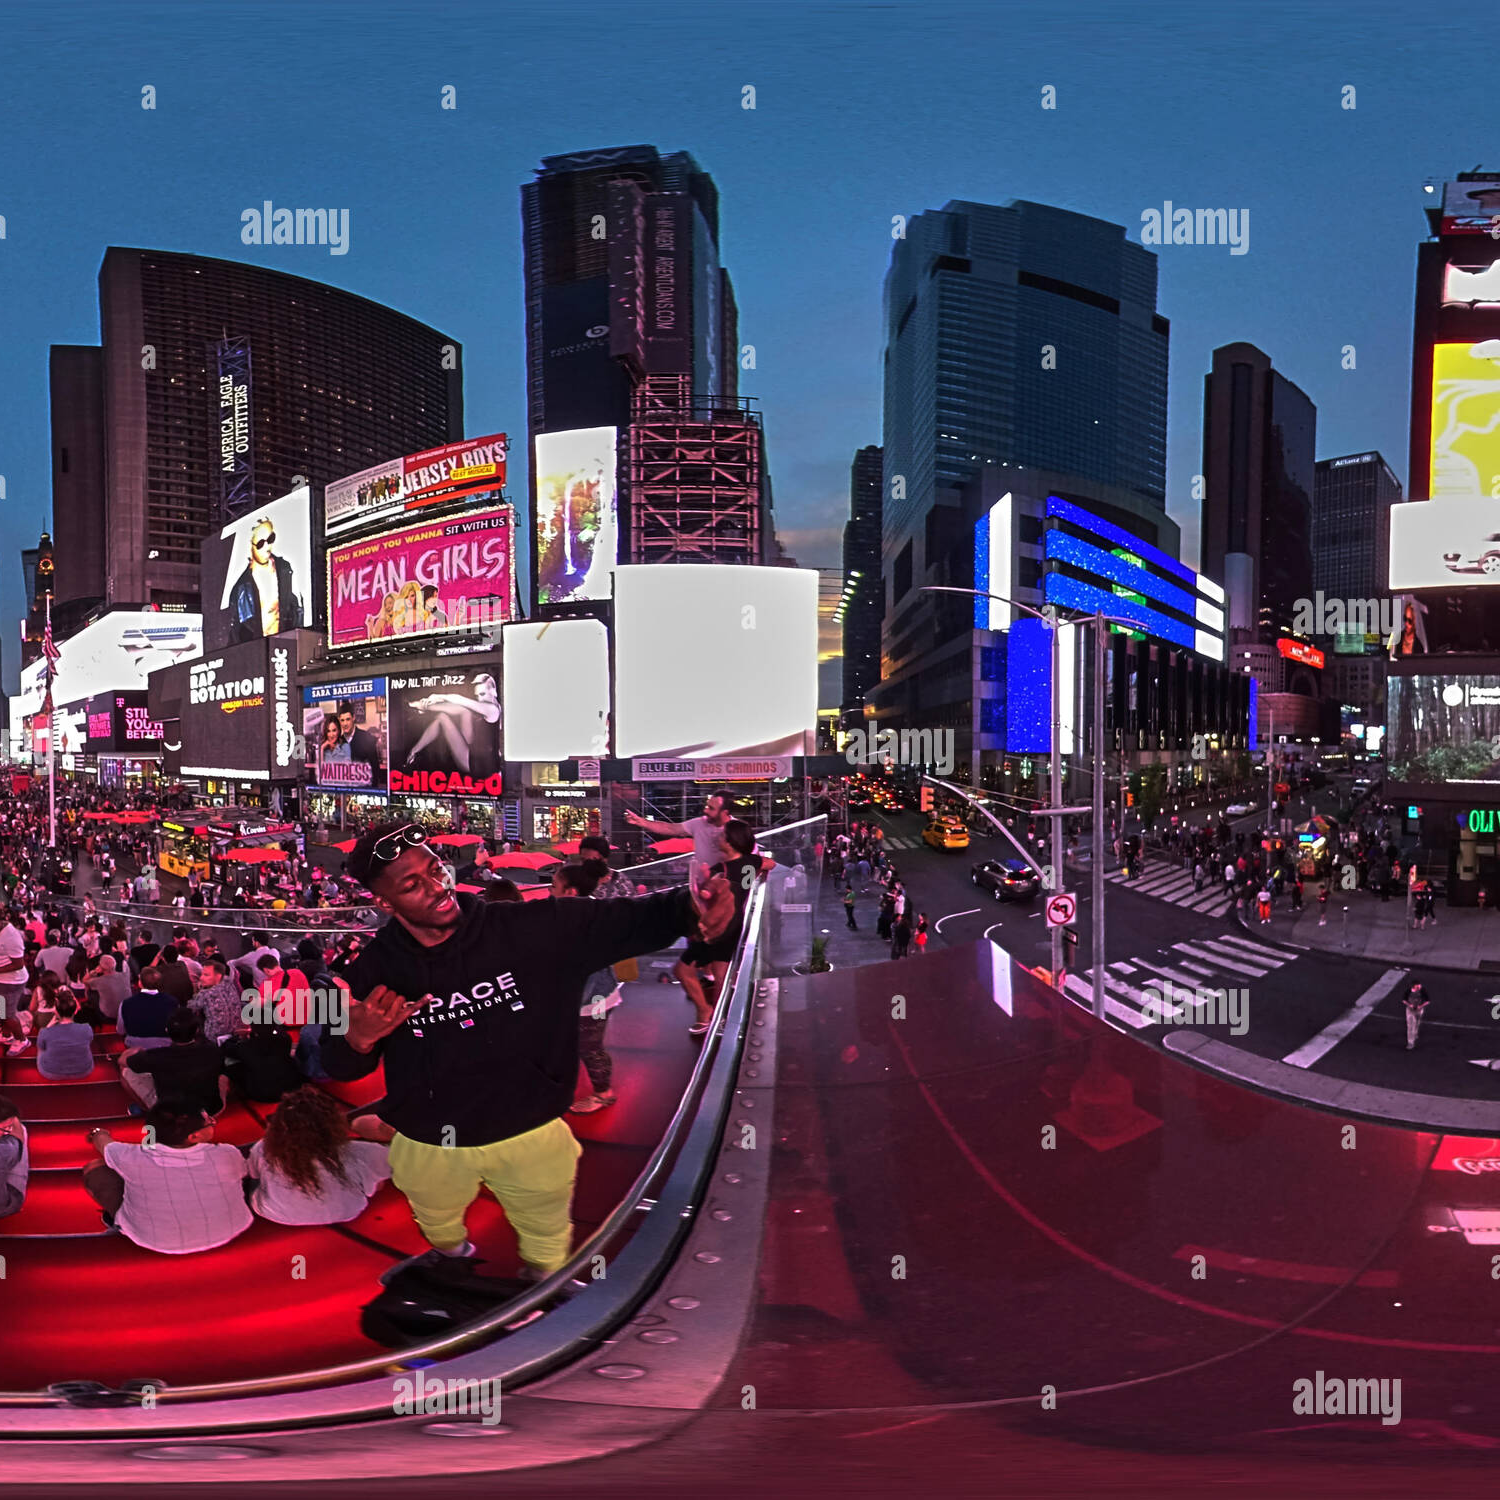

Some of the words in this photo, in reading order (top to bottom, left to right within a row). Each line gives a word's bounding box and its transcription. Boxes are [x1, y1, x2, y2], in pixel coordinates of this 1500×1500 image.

[655, 256, 675, 330] ARGENTLOANS.COM
[220, 374, 233, 408] EAGLE
[234, 384, 249, 453] OUTFITTERS
[221, 416, 235, 472] AMERICA
[403, 455, 457, 495] JERSEY
[461, 441, 507, 469] BOYS
[334, 554, 350, 564] YOU
[352, 545, 380, 559] KNOW
[383, 539, 402, 550] YOU
[404, 529, 444, 544] WANNA
[445, 526, 460, 535] SIT
[462, 520, 489, 533] WITH
[337, 556, 406, 608] MEAN
[414, 537, 505, 588] GIRLS
[190, 670, 216, 690] RAP
[271, 647, 289, 700] music
[391, 678, 406, 689] AND
[408, 678, 420, 688] ALL
[421, 676, 440, 687] THAT
[442, 674, 465, 686] JAZZ
[190, 677, 265, 705] ROTATION
[243, 695, 264, 707] music
[311, 689, 331, 698] SARA
[332, 684, 373, 696] BAREILLES
[125, 708, 149, 719] STIL
[126, 730, 164, 740] BETTER
[319, 762, 370, 782] WAITRESS
[639, 762, 669, 774] BLUE
[674, 762, 694, 772] FIN
[701, 763, 723, 774] DOS
[727, 761, 778, 774] CAMINOS
[389, 769, 502, 796] CHICAGO
[406, 989, 520, 1025] INTERNATIONAL
